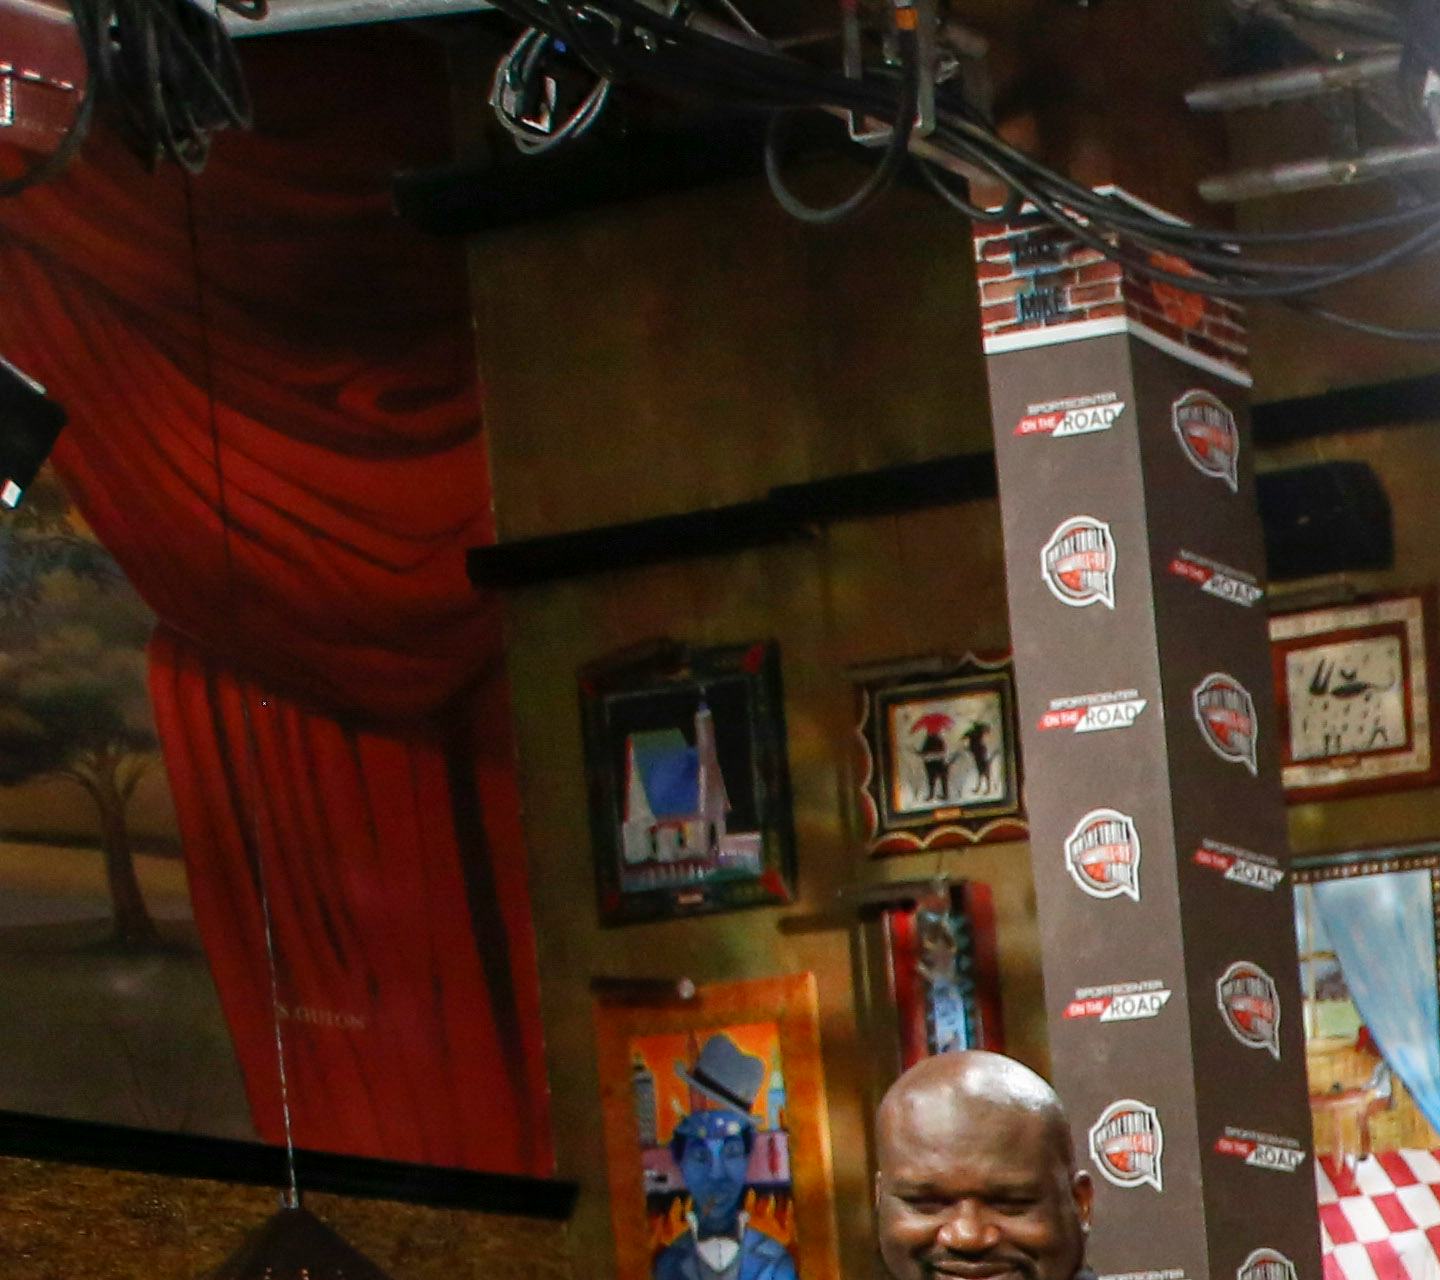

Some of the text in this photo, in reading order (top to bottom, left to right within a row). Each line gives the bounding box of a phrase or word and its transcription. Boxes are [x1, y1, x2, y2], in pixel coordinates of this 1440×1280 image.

[1063, 408, 1116, 430] ROAD
[1086, 706, 1137, 726] ROAD
[1111, 996, 1161, 1016] ROAD
